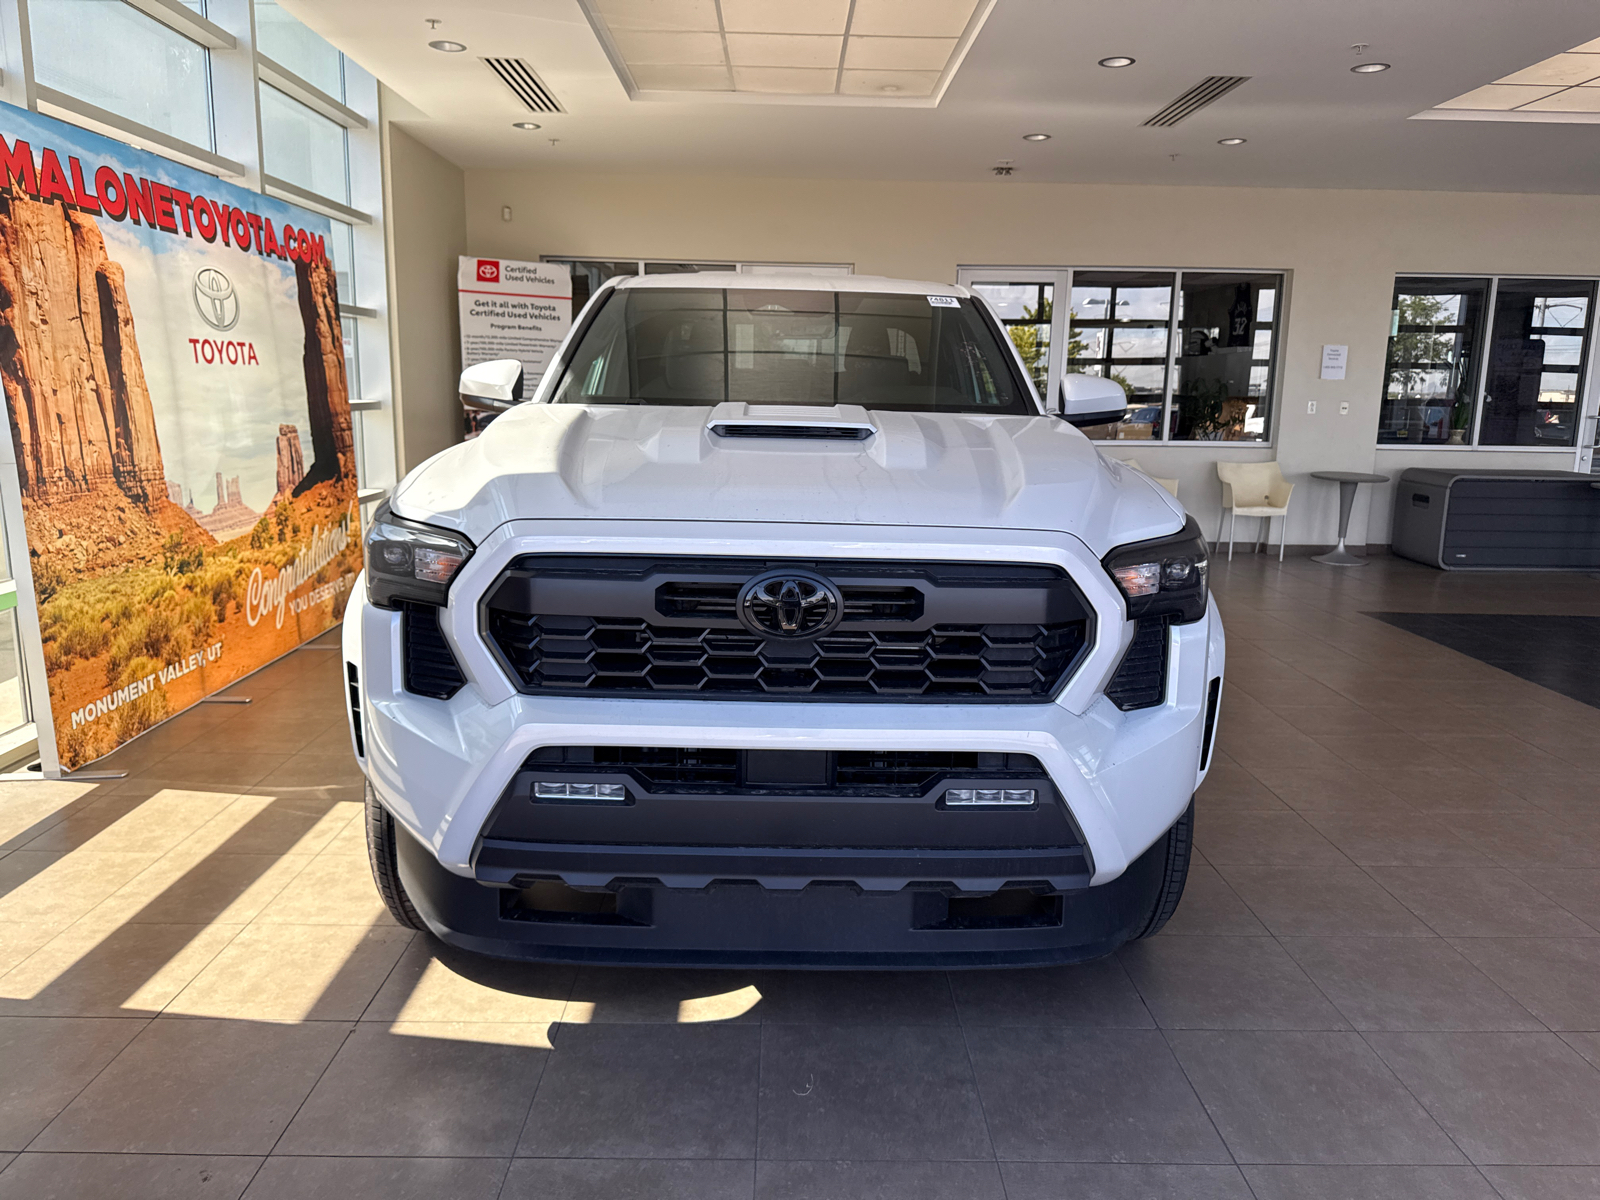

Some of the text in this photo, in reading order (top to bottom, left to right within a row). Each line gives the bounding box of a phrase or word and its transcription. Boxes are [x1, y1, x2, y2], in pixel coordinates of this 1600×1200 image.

[0, 133, 328, 266] MALONETOYOTA.COM
[504, 265, 537, 275] Certified
[504, 274, 555, 285] Used Vehicles
[474, 299, 556, 312] Get it all with Toyota
[469, 309, 561, 321] Certified Used Vehicles
[490, 323, 542, 332] Program Benefits
[188, 338, 260, 366] TOYOTA
[288, 595, 309, 616] YOU
[308, 576, 346, 607] DESERVE
[70, 641, 223, 731] MONUMENT VALLEY, UT
